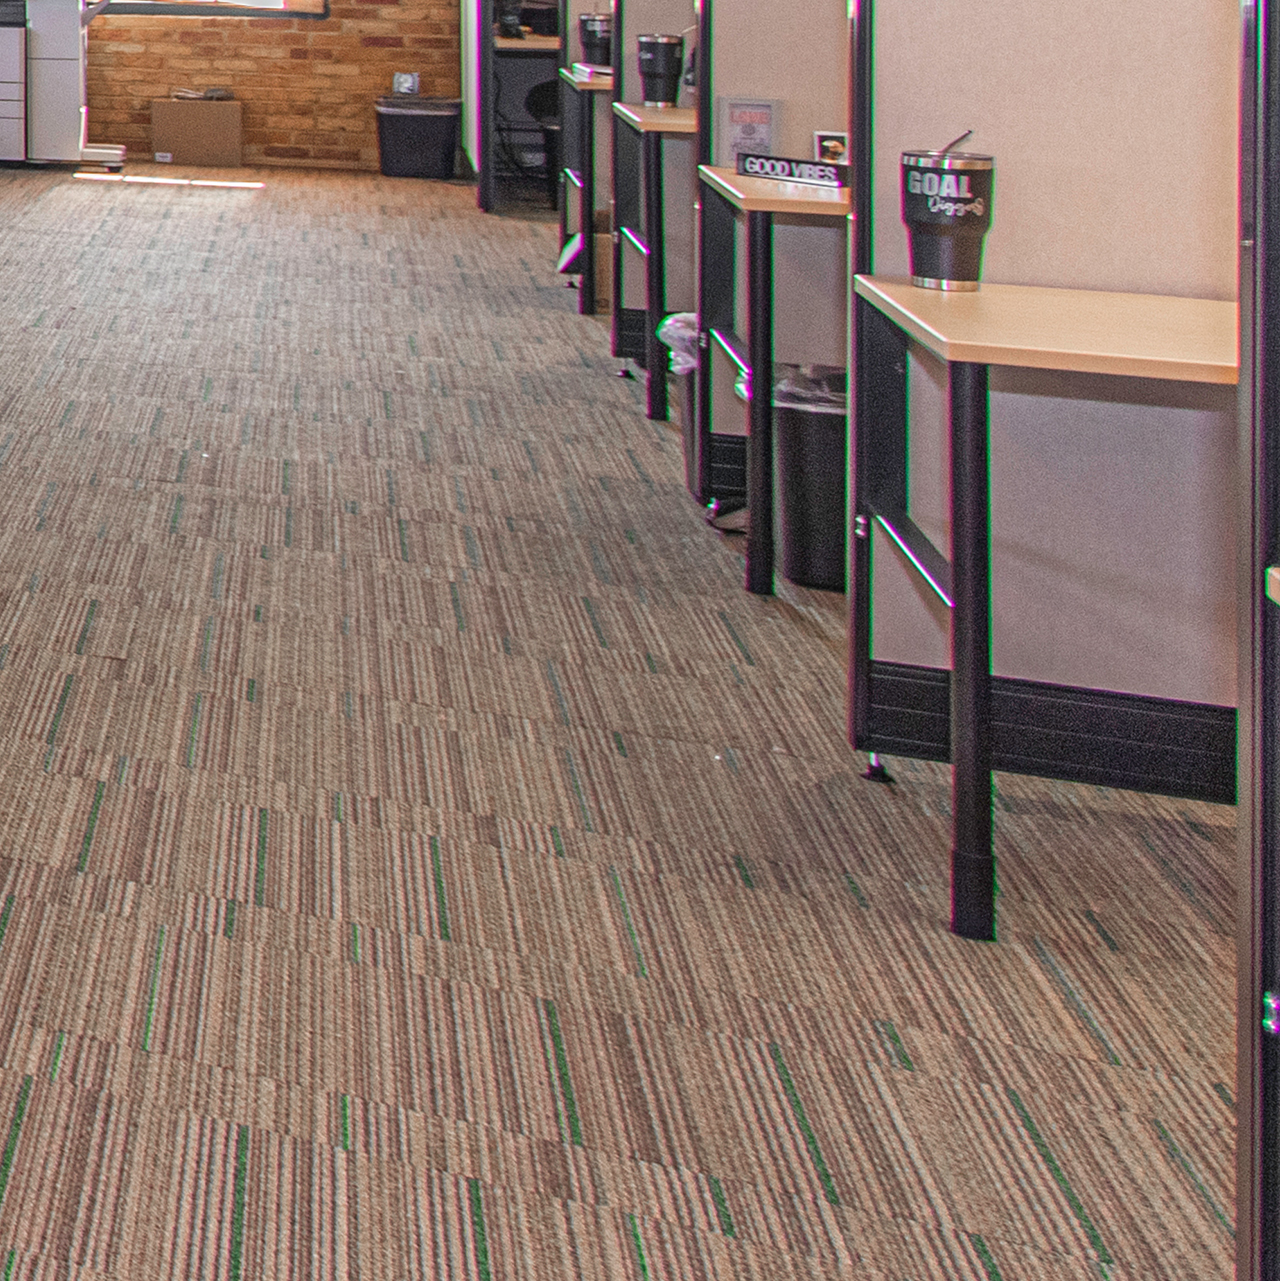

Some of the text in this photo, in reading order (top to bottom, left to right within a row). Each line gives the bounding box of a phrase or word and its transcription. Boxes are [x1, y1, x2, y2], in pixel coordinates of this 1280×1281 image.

[745, 157, 838, 182] GOOD VIBES
[907, 170, 973, 198] GOAL
